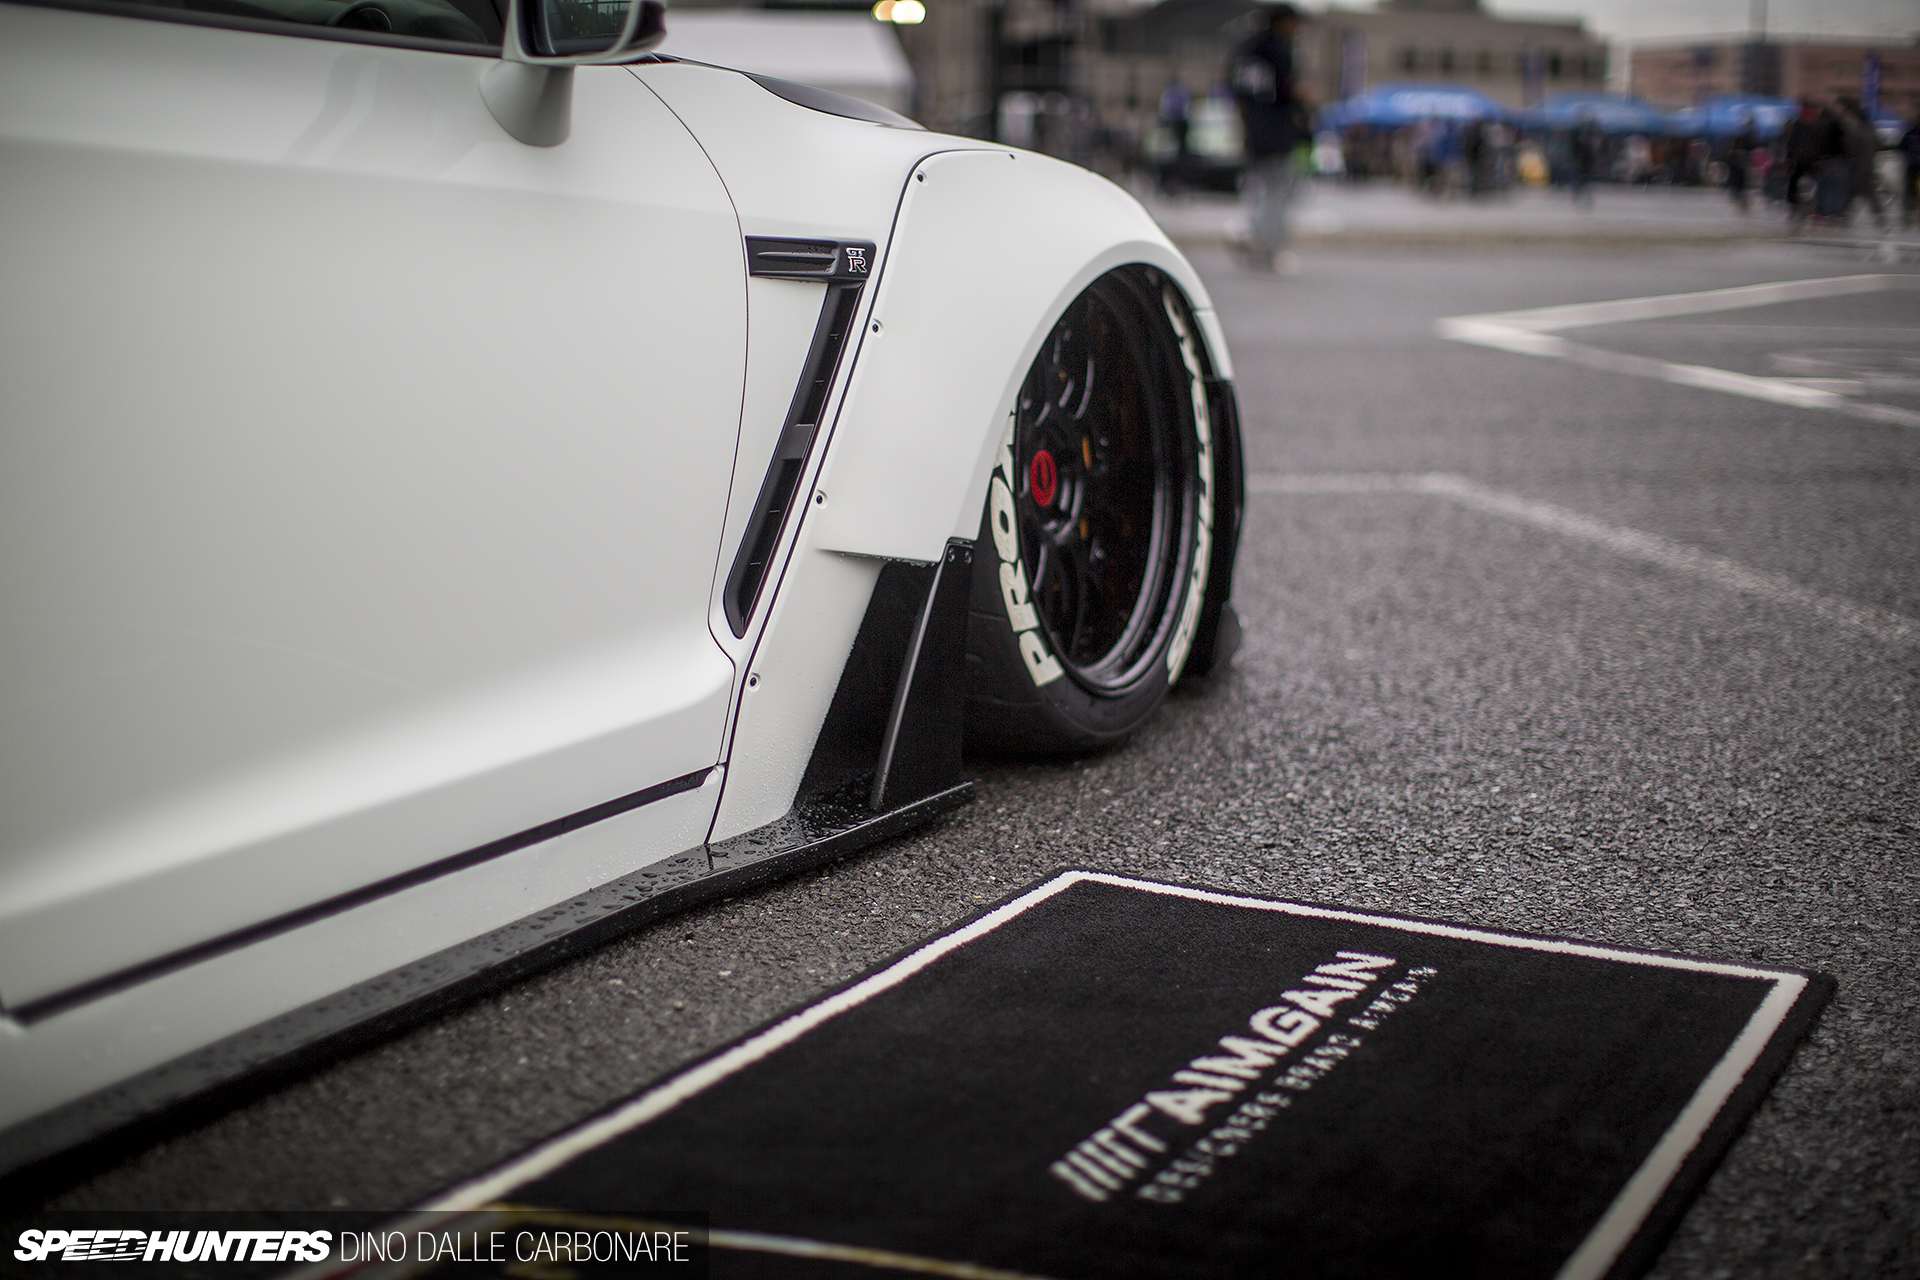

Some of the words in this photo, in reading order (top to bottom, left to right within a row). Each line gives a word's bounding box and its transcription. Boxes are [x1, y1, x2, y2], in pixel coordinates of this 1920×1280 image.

[846, 247, 866, 257] GT
[847, 256, 867, 273] R
[990, 398, 1065, 687] PROX
